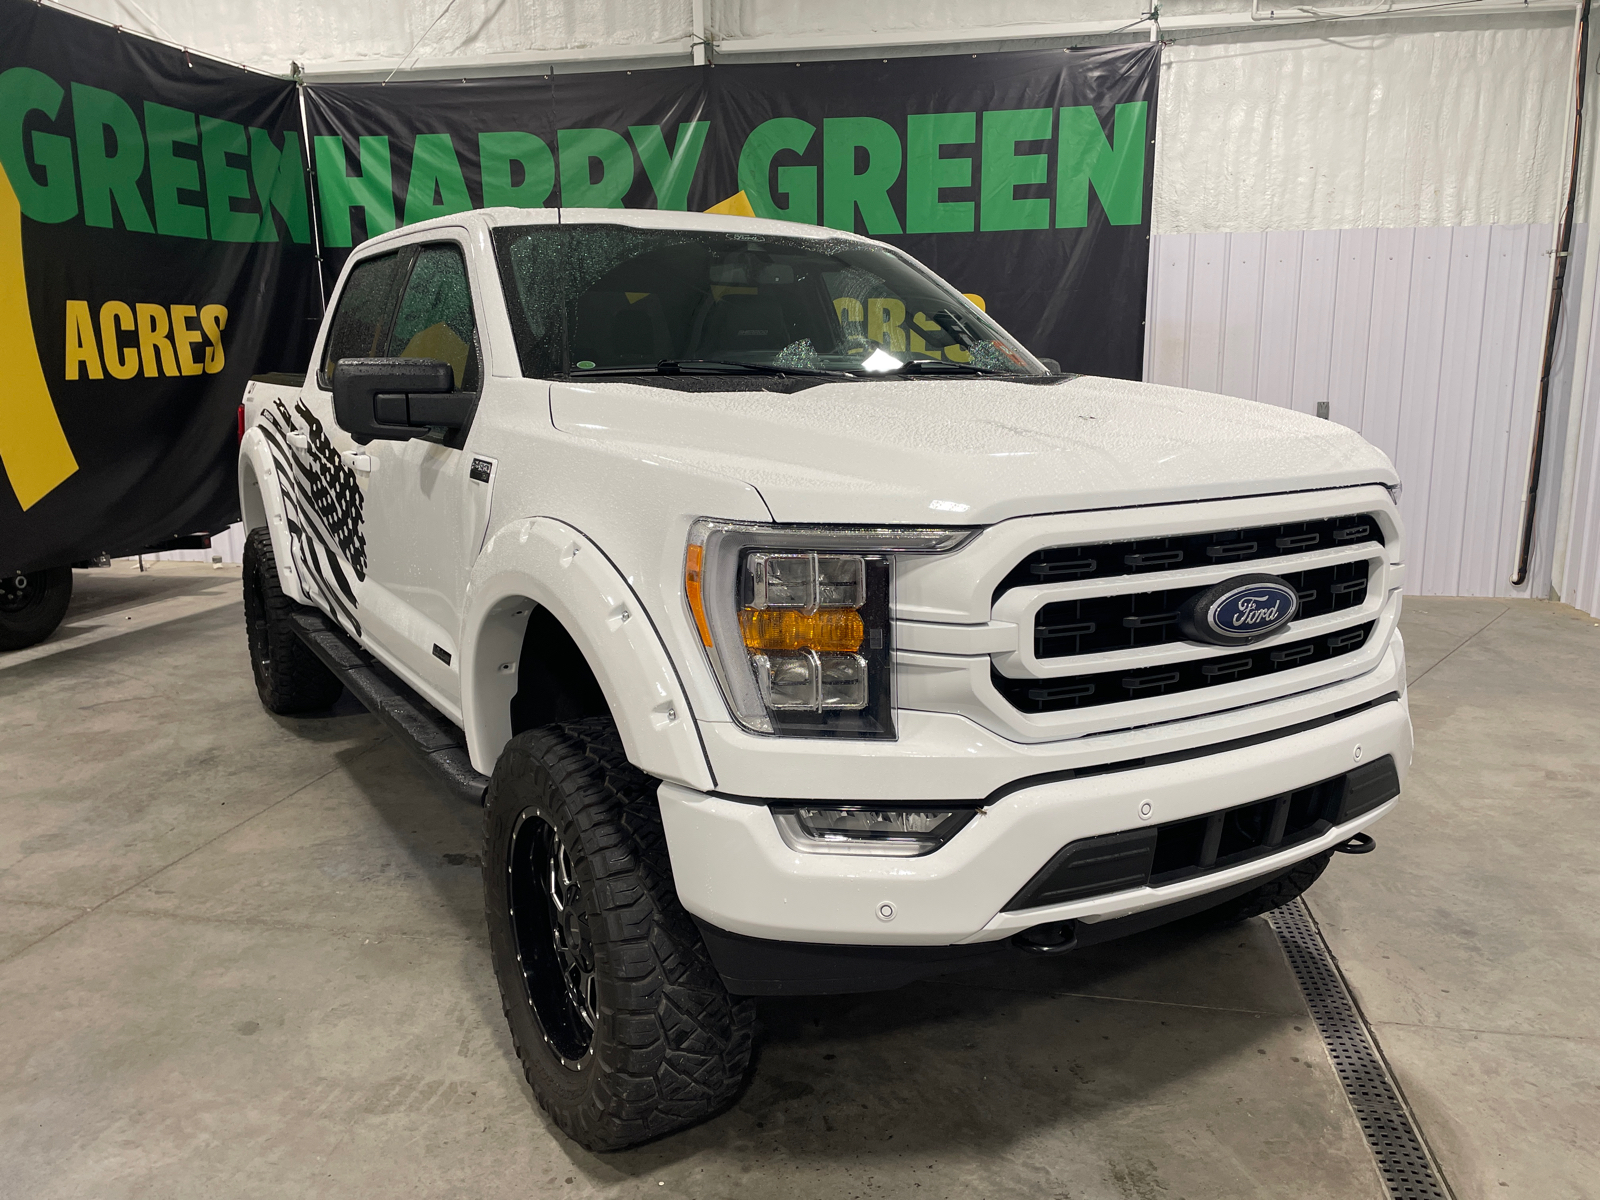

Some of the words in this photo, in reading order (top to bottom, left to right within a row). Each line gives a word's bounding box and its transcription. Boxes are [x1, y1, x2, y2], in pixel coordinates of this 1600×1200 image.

[0, 67, 311, 244] GREEN
[314, 121, 711, 248] HAPPY
[738, 101, 1148, 235] GREEN
[65, 300, 229, 380] ACRES
[1233, 595, 1280, 627] Ford
